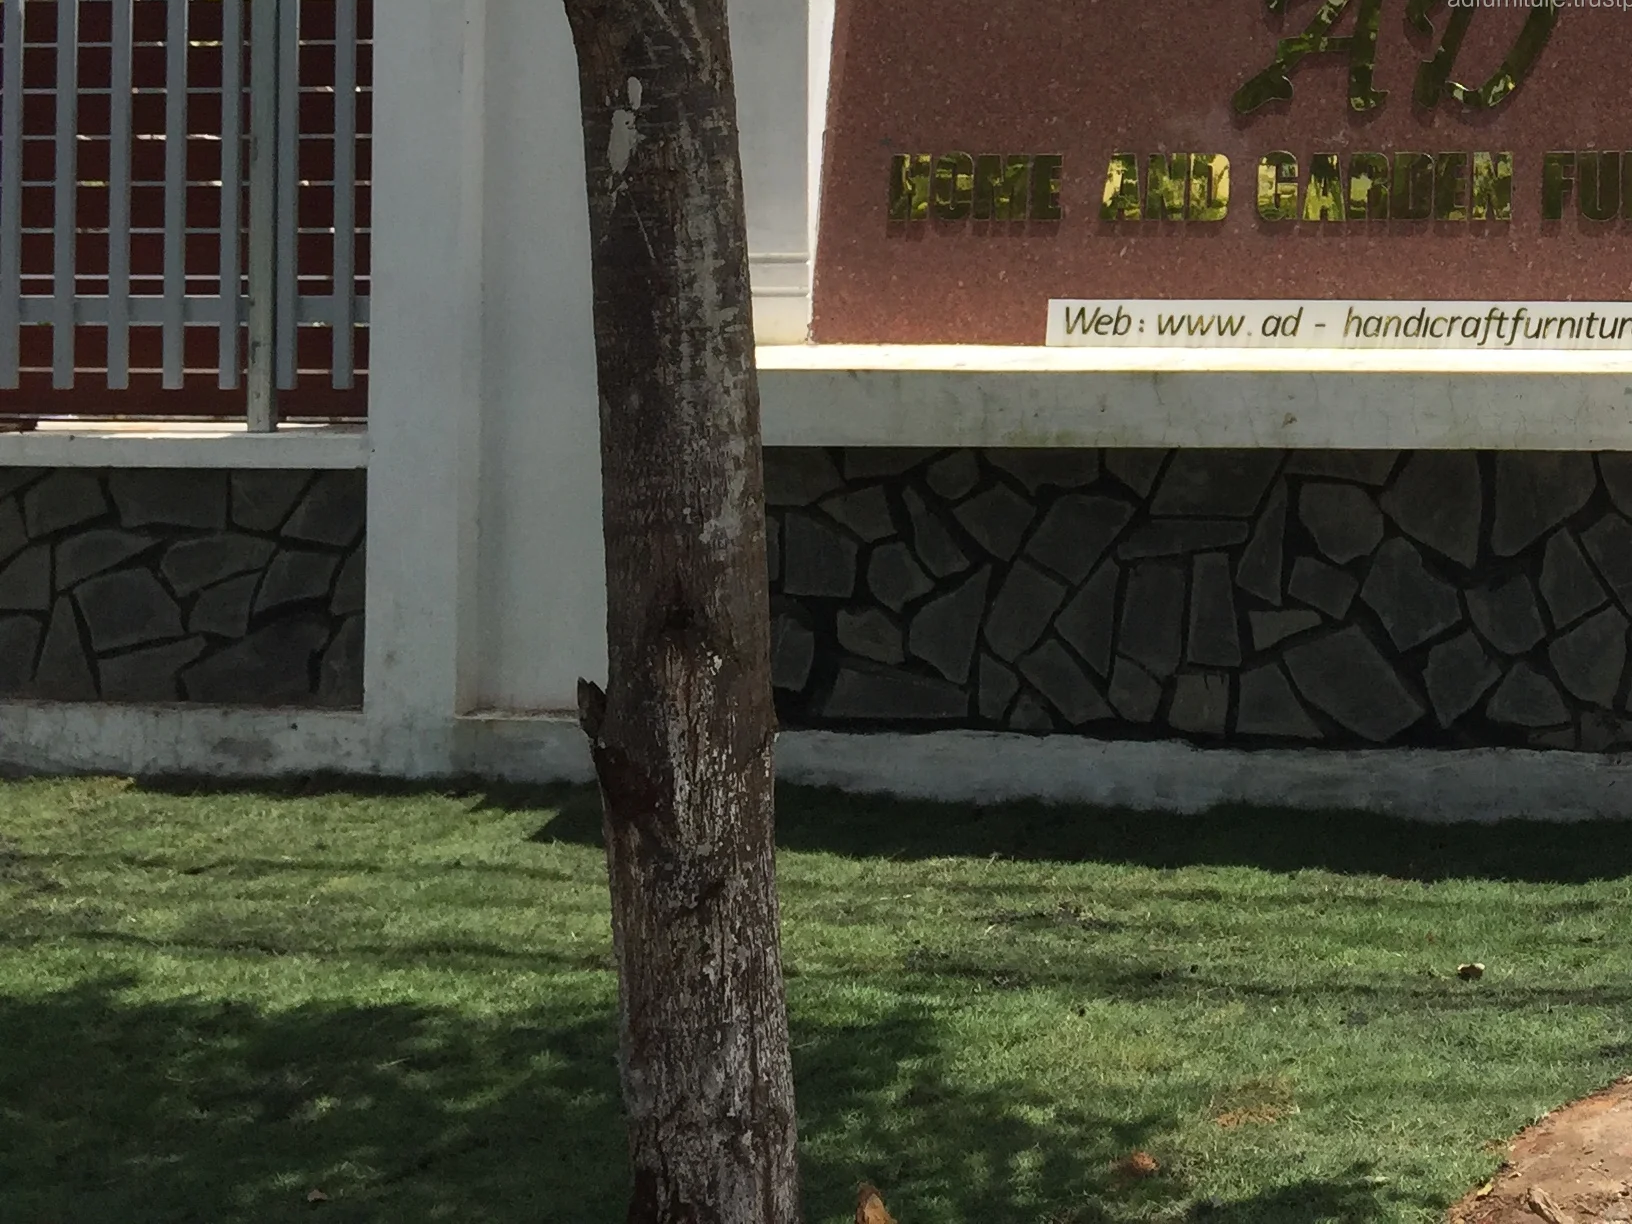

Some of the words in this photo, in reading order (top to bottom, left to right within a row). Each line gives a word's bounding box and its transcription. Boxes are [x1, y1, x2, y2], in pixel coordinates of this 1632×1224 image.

[889, 150, 1064, 222] HOME
[1100, 152, 1231, 222] AND
[1257, 150, 1513, 222] GARDEN
